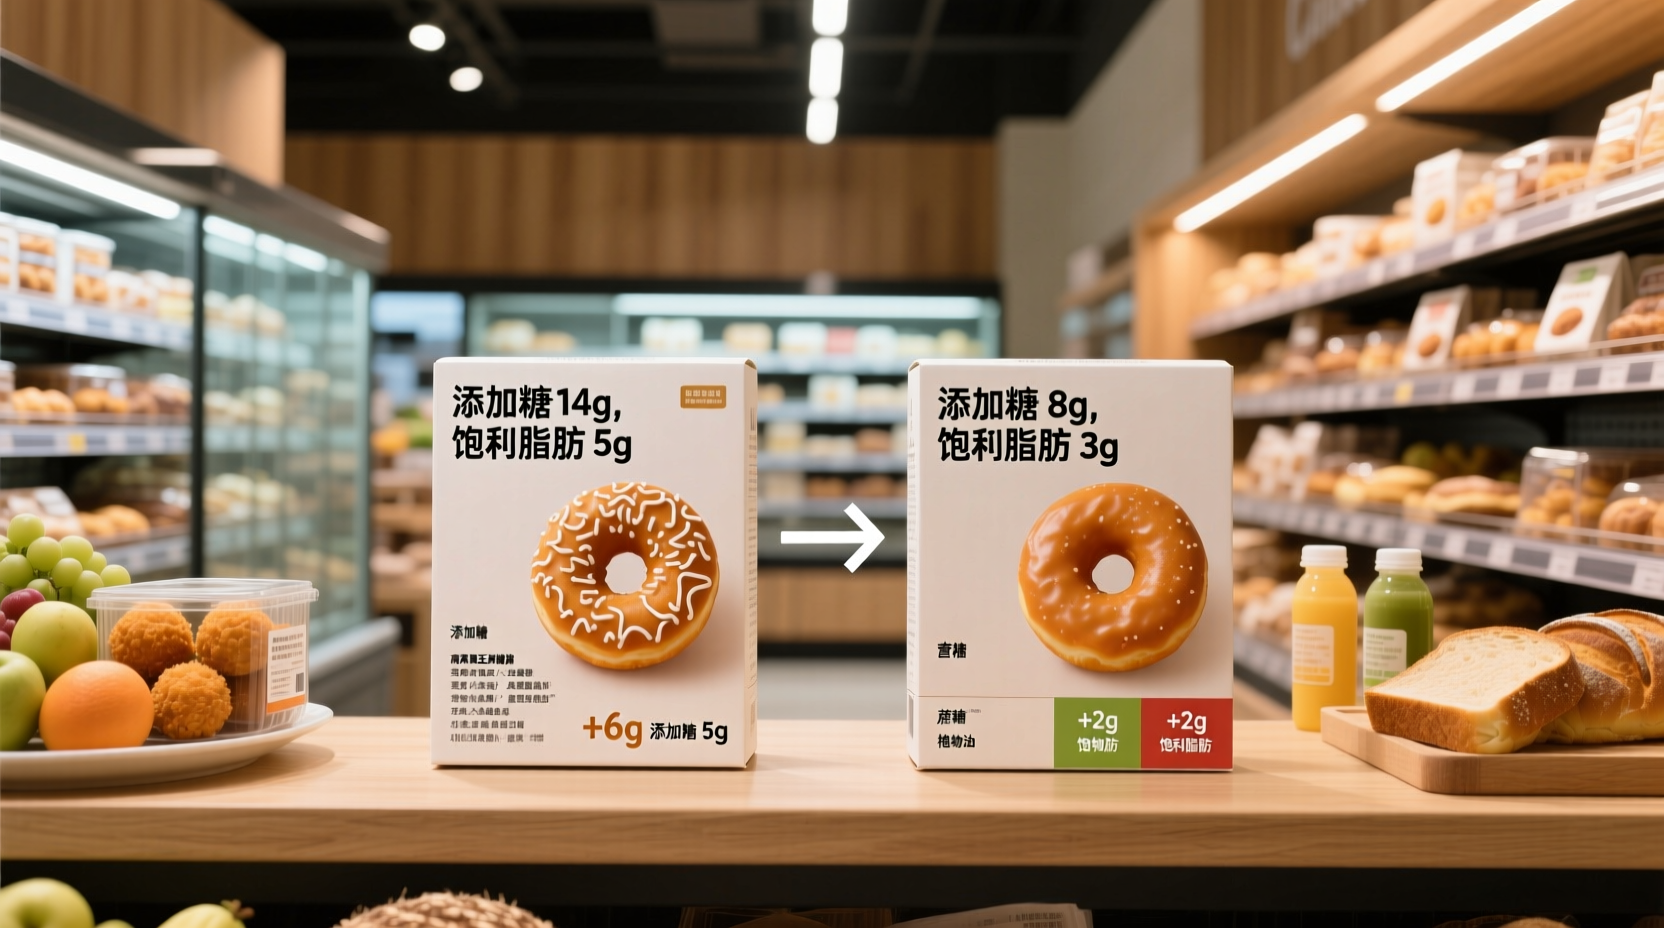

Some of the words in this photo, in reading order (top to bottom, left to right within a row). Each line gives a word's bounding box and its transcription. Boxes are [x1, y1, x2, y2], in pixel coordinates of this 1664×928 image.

[938, 385, 1040, 421] 添加糖
[1048, 389, 1098, 426] 8g,
[452, 425, 586, 461] 饱利脂肪
[593, 428, 632, 464] 5g
[936, 426, 1072, 463] 饱利脂肪
[1080, 431, 1119, 467] 3g
[582, 711, 643, 749] +6g
[702, 720, 728, 746] 5g
[1077, 709, 1118, 735] +2g
[1166, 710, 1207, 735] +2g
